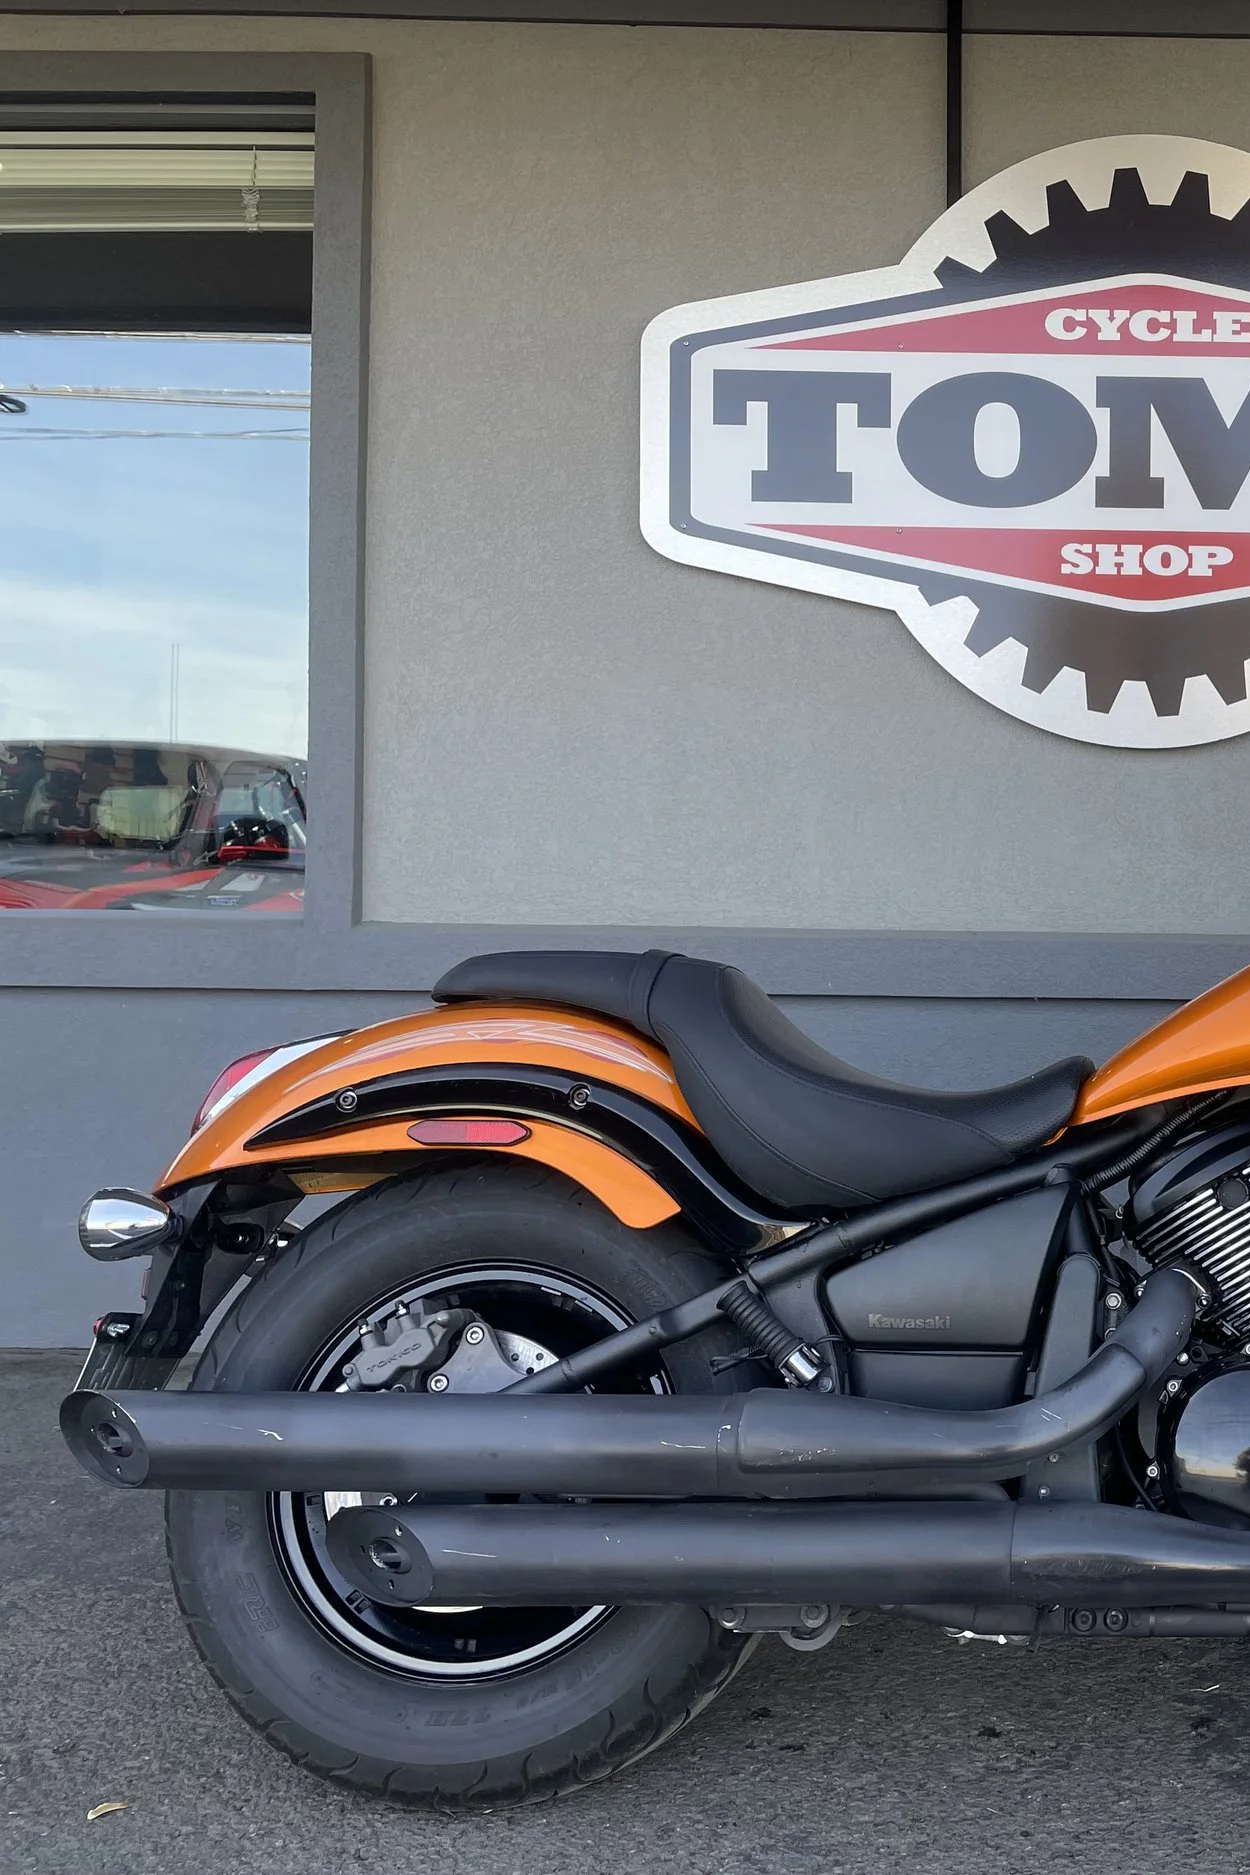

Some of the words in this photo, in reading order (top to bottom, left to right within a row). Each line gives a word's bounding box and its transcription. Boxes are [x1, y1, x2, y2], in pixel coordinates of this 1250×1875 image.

[1061, 543, 1234, 576] SHOP
[867, 1313, 951, 1329] Kawasaki
[366, 1343, 422, 1373] TOKICO
